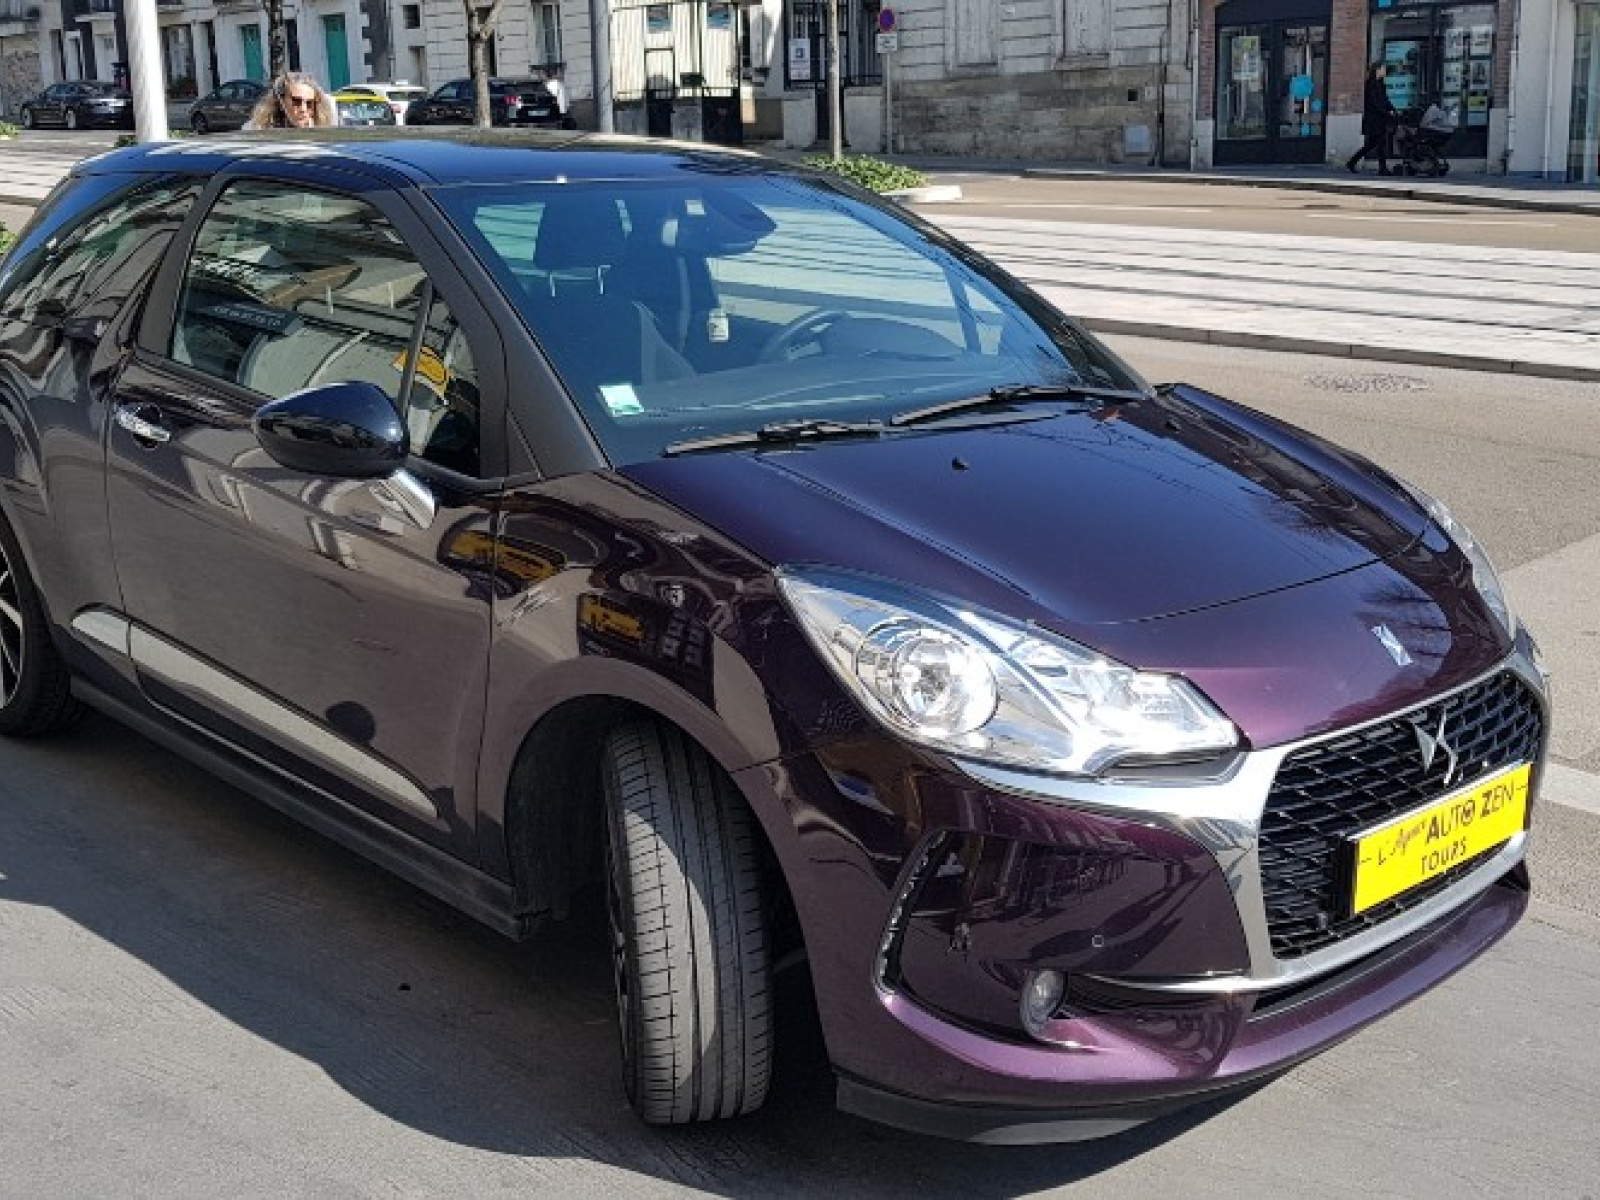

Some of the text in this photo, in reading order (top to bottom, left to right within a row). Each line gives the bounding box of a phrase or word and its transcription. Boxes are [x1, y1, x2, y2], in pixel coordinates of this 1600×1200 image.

[1427, 799, 1476, 844] AUTO
[1480, 780, 1515, 818] ZEN
[1421, 836, 1467, 875] TOURS
